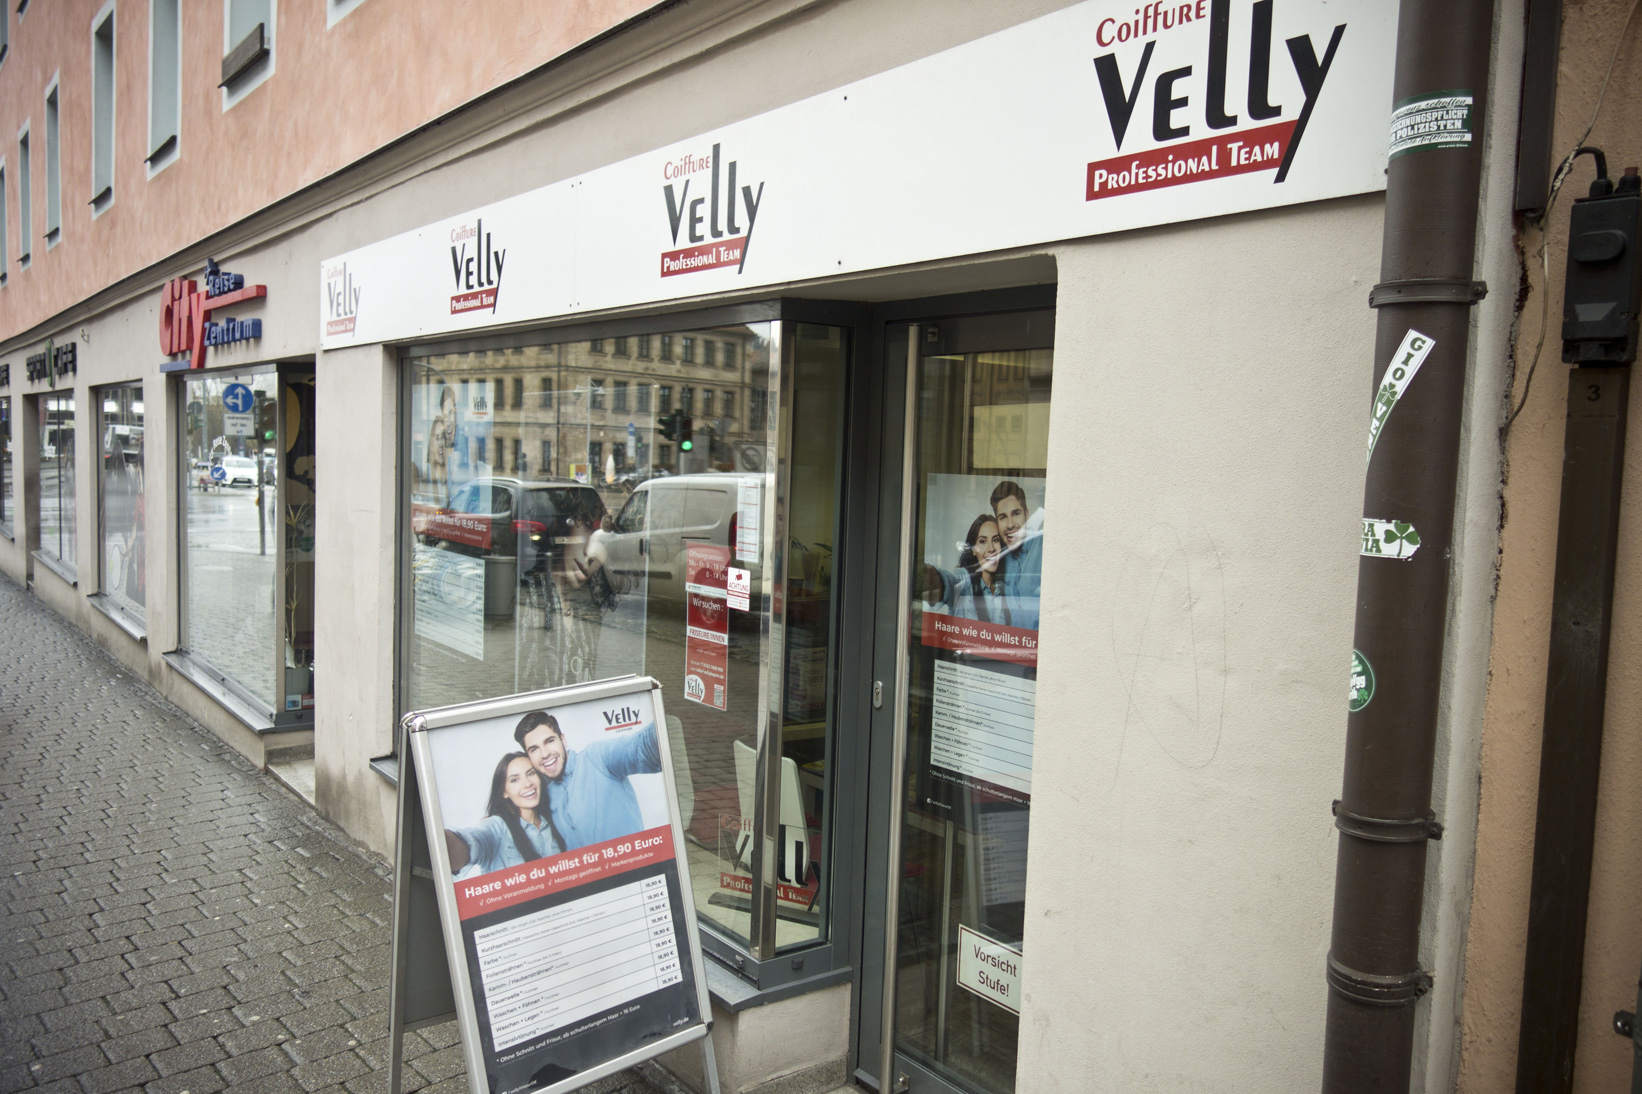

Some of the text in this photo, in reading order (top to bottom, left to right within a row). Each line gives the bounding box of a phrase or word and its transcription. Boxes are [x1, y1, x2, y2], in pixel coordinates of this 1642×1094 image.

[1397, 119, 1463, 140] POLIZISTEN
[1093, 141, 1279, 192] Professional Team
[663, 142, 765, 275] Velly
[451, 218, 506, 314] Velly
[663, 246, 741, 273] Professional Team
[208, 273, 240, 296] Reise
[327, 261, 361, 338] Velly
[452, 292, 495, 312] Professional Team
[204, 318, 258, 347] Zentrum
[1392, 337, 1427, 381] GIO
[1586, 384, 1601, 402] 3
[935, 621, 1036, 648] Haare wie du willst für
[602, 706, 640, 725] Velly
[464, 836, 663, 899] Haare wie du willst für 18,90 Euro:
[486, 852, 653, 904] Ohne Voranmeldung Montags geöffnet Markenprodukte
[649, 904, 661, 912] 18,90
[651, 916, 663, 924] 18,90
[479, 926, 508, 940] Haarschnitt
[653, 928, 665, 936] 18,90
[481, 937, 520, 953] Kurzhaarschnitt
[655, 940, 668, 948] 18,90
[484, 958, 499, 966] Farbe
[974, 944, 1017, 977] Vorsicht
[661, 977, 674, 985] 18,90
[978, 970, 1010, 997] Stufe!
[491, 993, 520, 1006] Dauerwelle
[493, 1006, 517, 1019] Waschen
[522, 998, 540, 1009] Föhnen
[495, 1019, 519, 1032] Waschen
[524, 1012, 540, 1022] Legen
[500, 1052, 515, 1063] Ohne
[516, 1046, 535, 1058] Schnitt
[536, 1041, 546, 1050] und
[563, 1031, 570, 1039] ab
[570, 1018, 607, 1036] schulterlangem
[608, 1012, 619, 1021] Haar
